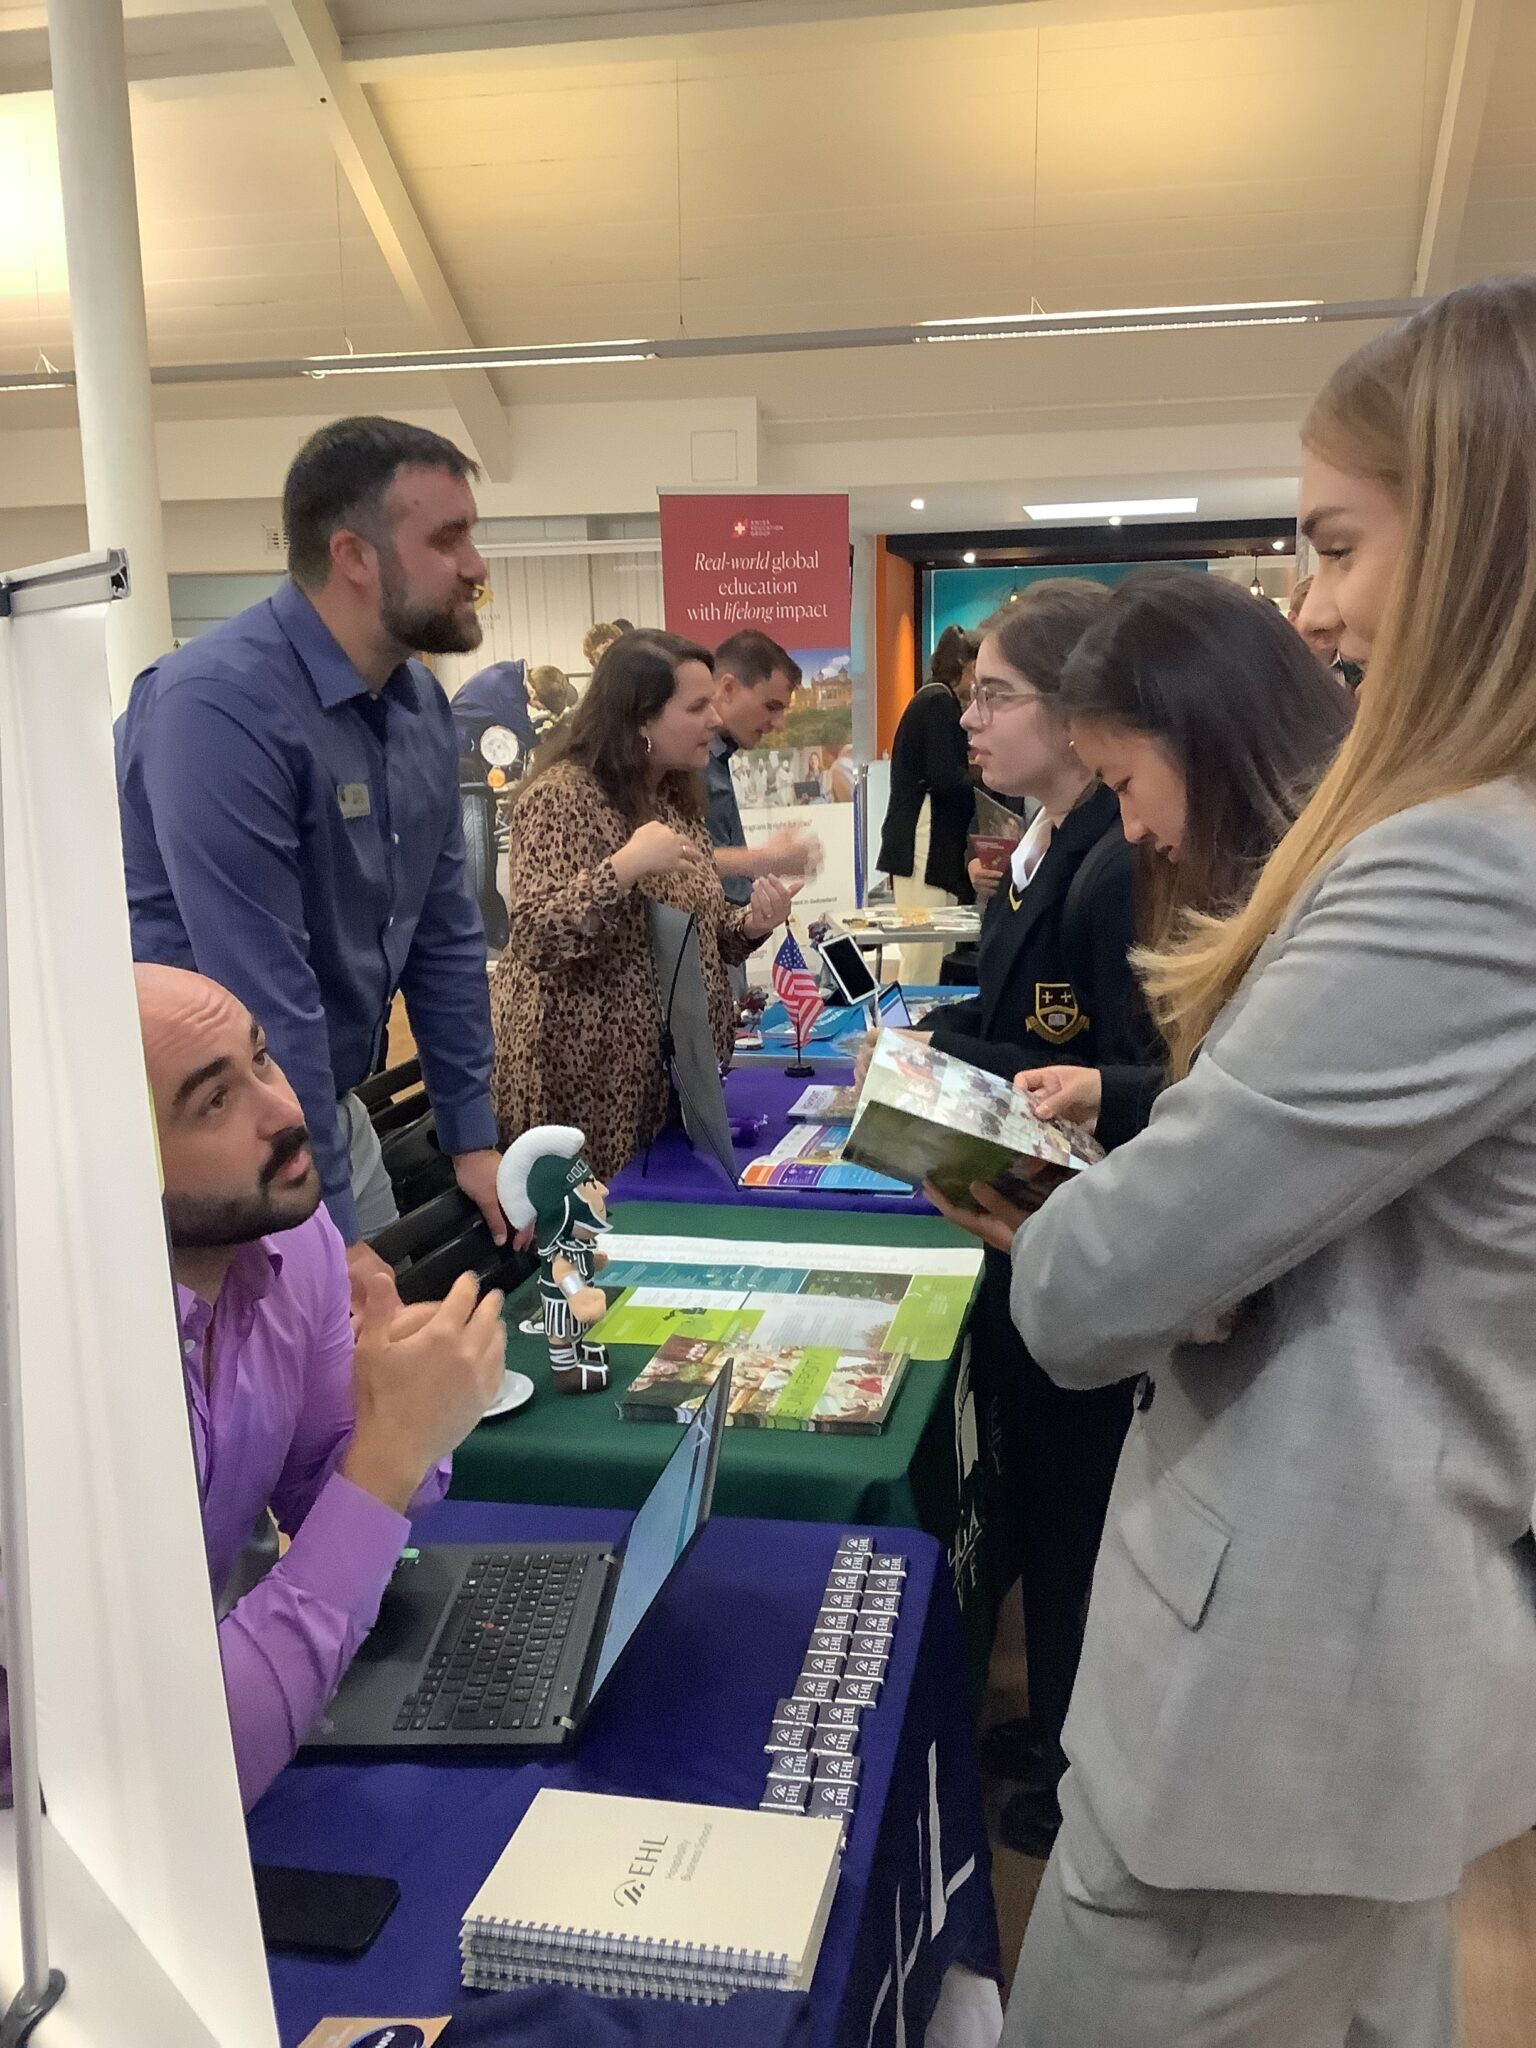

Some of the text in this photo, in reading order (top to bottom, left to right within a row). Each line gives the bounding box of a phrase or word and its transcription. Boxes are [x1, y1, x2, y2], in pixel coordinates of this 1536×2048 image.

[694, 550, 819, 574] Real-world global
[718, 577, 798, 596] education
[687, 602, 828, 624] with lifelong impact
[857, 1537, 870, 1551] EHL
[852, 1556, 864, 1569] EHL
[891, 1557, 902, 1570] EHL
[846, 1575, 858, 1589] EHL
[887, 1577, 899, 1591] EHL
[841, 1593, 854, 1608] EHL
[884, 1596, 896, 1611] EHL
[836, 1614, 848, 1629] EHL
[877, 1617, 890, 1631] EHL
[829, 1635, 842, 1651] EHL
[872, 1638, 886, 1653] EHL
[823, 1657, 837, 1673] EHL
[867, 1660, 882, 1676] EHL
[815, 1681, 829, 1697] EHL
[858, 1682, 873, 1699] EHL
[796, 1703, 810, 1722] EHL
[842, 1706, 856, 1724] EHL
[789, 1727, 804, 1747] EHL
[836, 1732, 852, 1751] EHL
[793, 1753, 808, 1773] EHL
[840, 1759, 855, 1778] EHL
[785, 1783, 801, 1803] EHL
[835, 1786, 850, 1806] EHL
[628, 1834, 669, 1877] EHL
